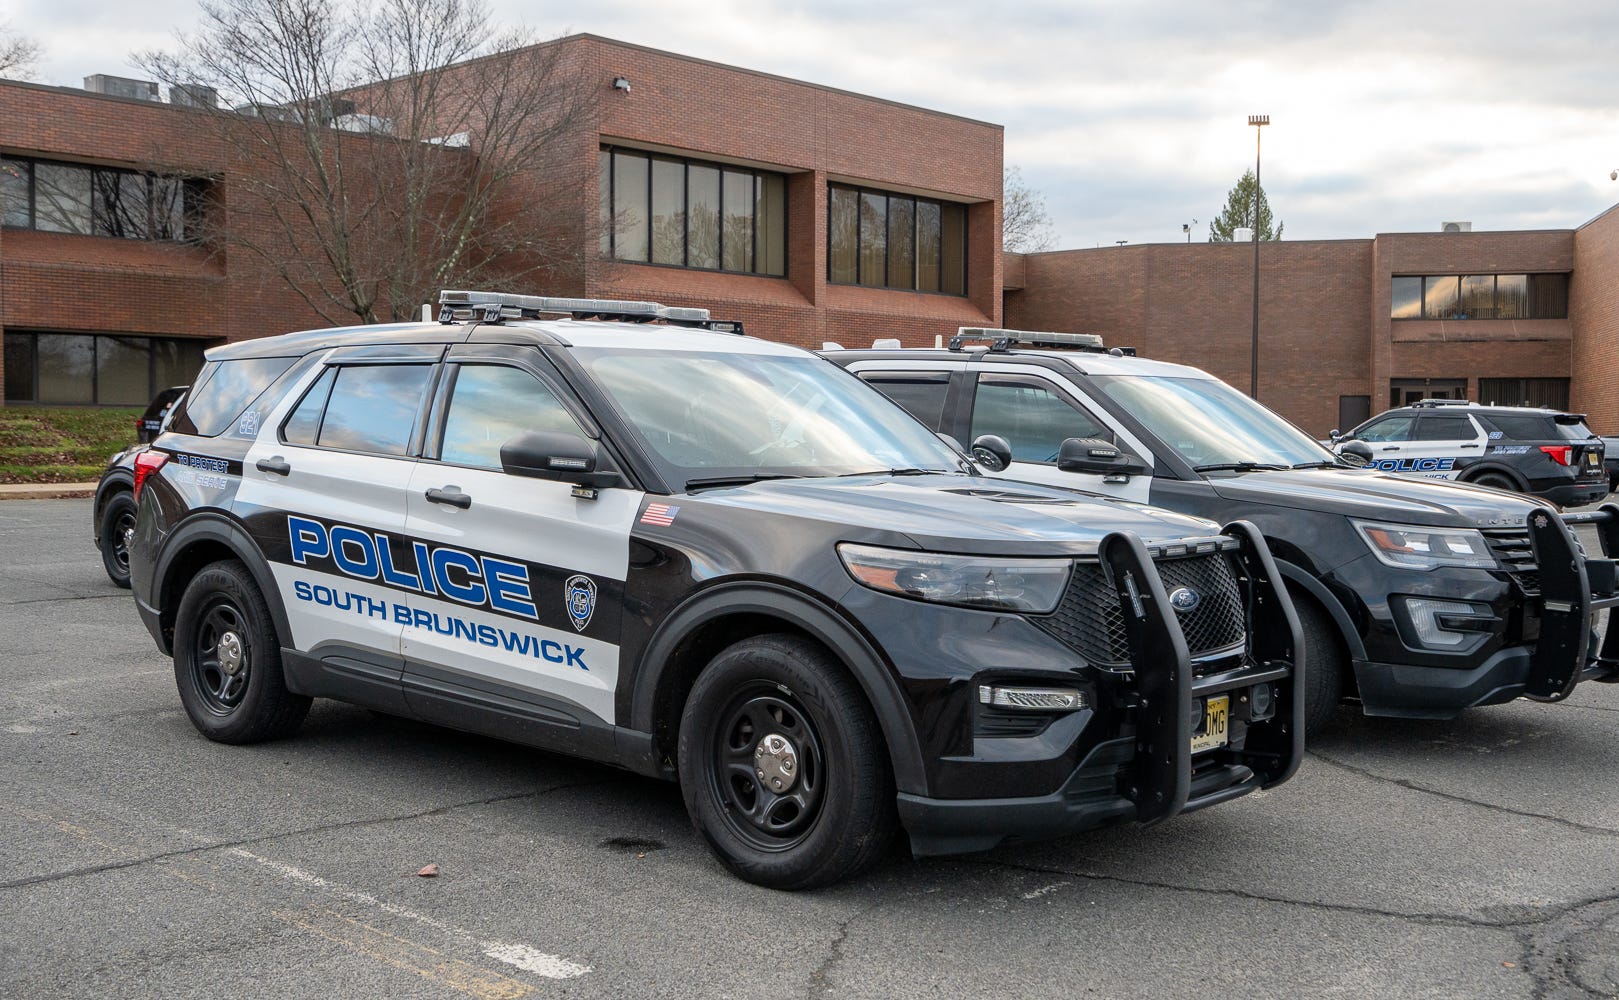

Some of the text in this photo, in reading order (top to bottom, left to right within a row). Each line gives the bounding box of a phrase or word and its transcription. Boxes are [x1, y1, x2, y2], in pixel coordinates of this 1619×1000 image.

[177, 454, 229, 474] TO PROTECT
[288, 515, 539, 620] POLICE
[294, 580, 590, 671] SOUTH BRUNSWICK
